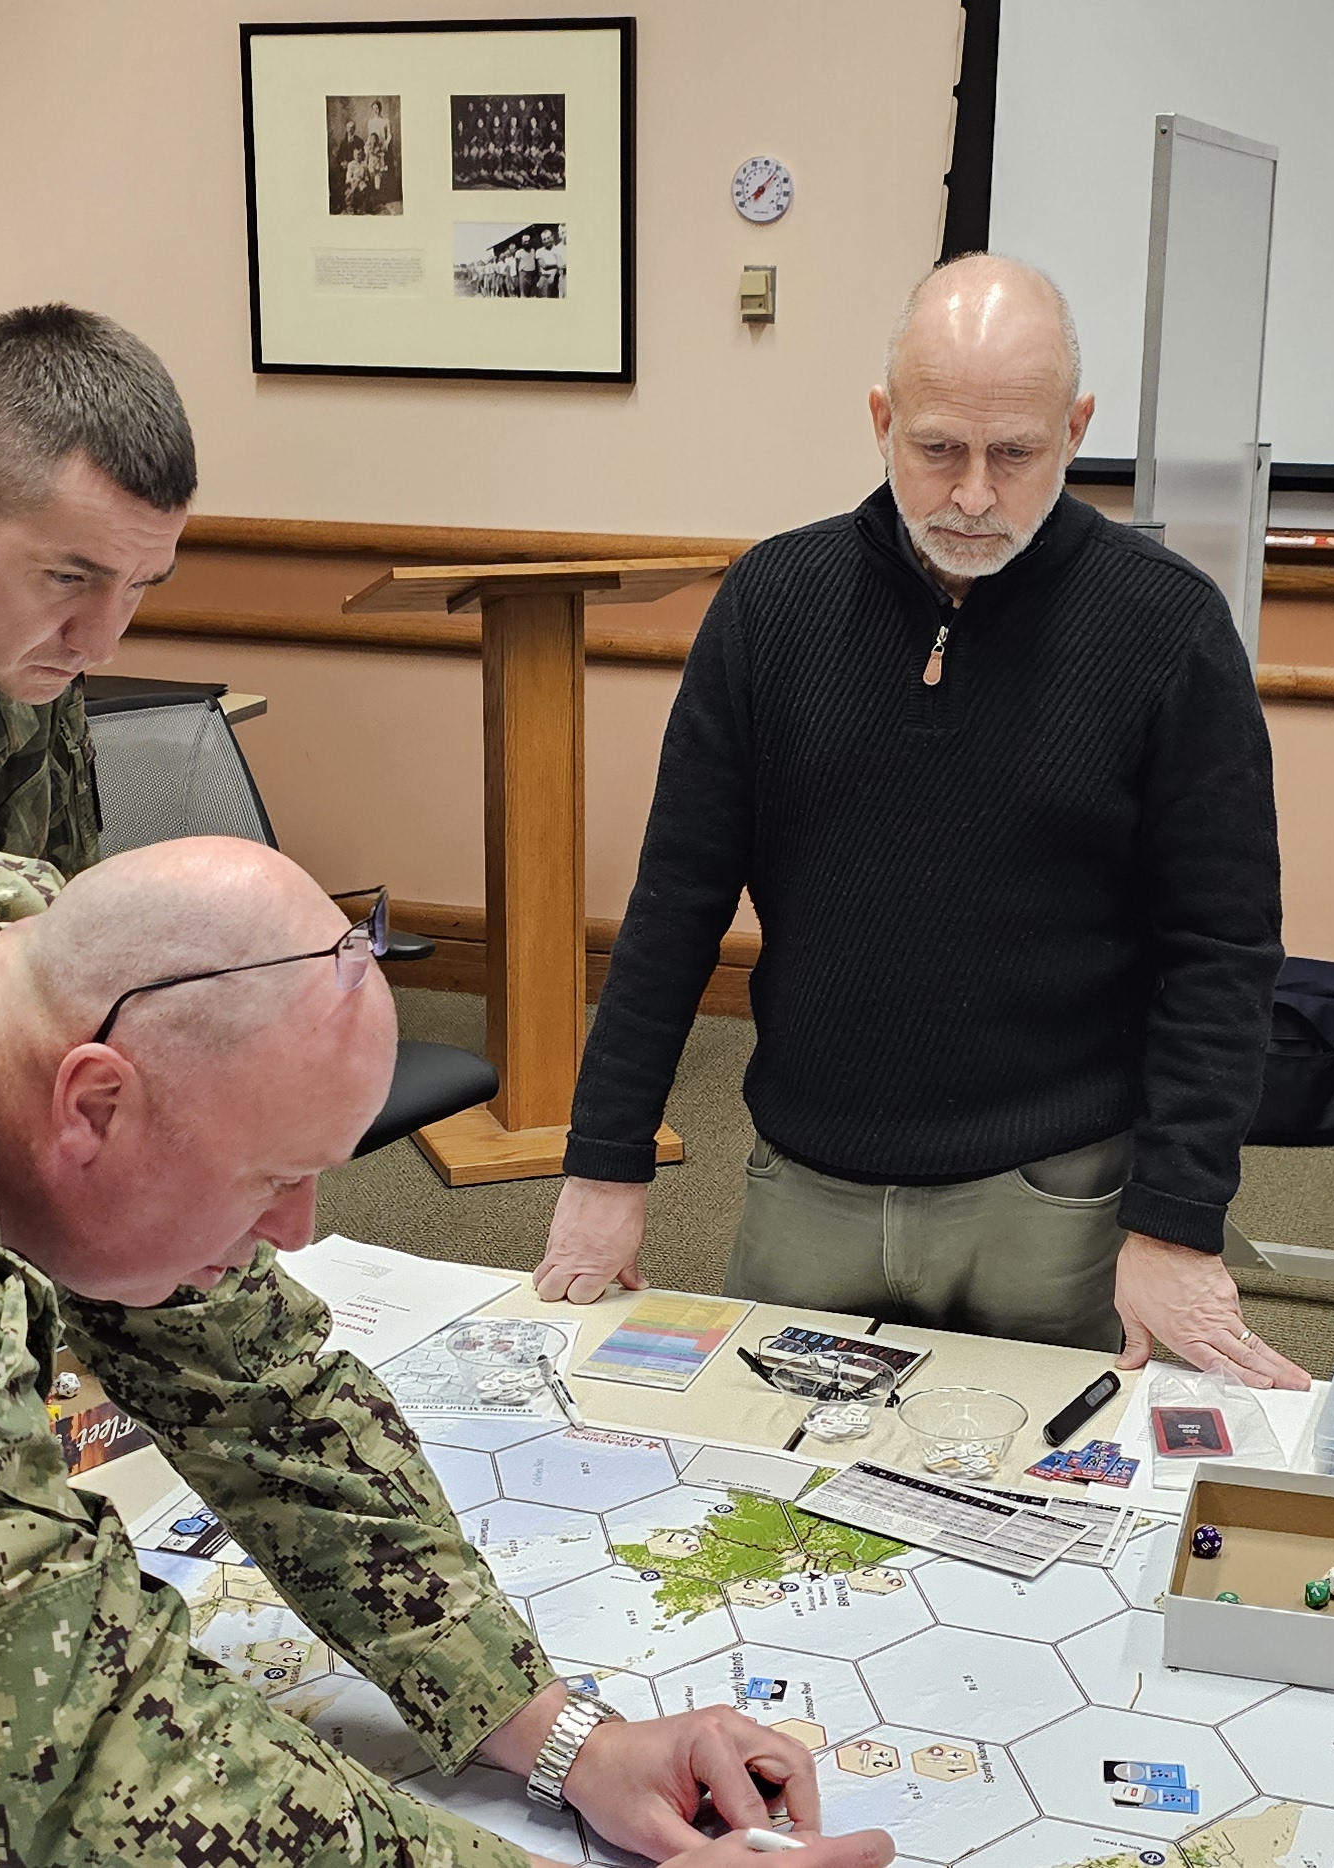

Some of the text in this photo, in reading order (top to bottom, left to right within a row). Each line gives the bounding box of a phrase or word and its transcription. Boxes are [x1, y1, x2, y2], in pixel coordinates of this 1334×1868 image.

[333, 1308, 378, 1324] Wargame
[332, 1320, 374, 1336] Operati
[480, 1406, 534, 1414] STARTING
[75, 1414, 137, 1452] Fleet
[479, 1518, 490, 1547] ARCHIPELAGO
[743, 1578, 759, 1590] 3
[833, 1578, 850, 1607] BRUNEI
[730, 1651, 749, 1711] Spratly Islands
[800, 1681, 816, 1720] Johnson Reef
[872, 1760, 893, 1769] 2
[982, 1761, 995, 1784] Spratly
